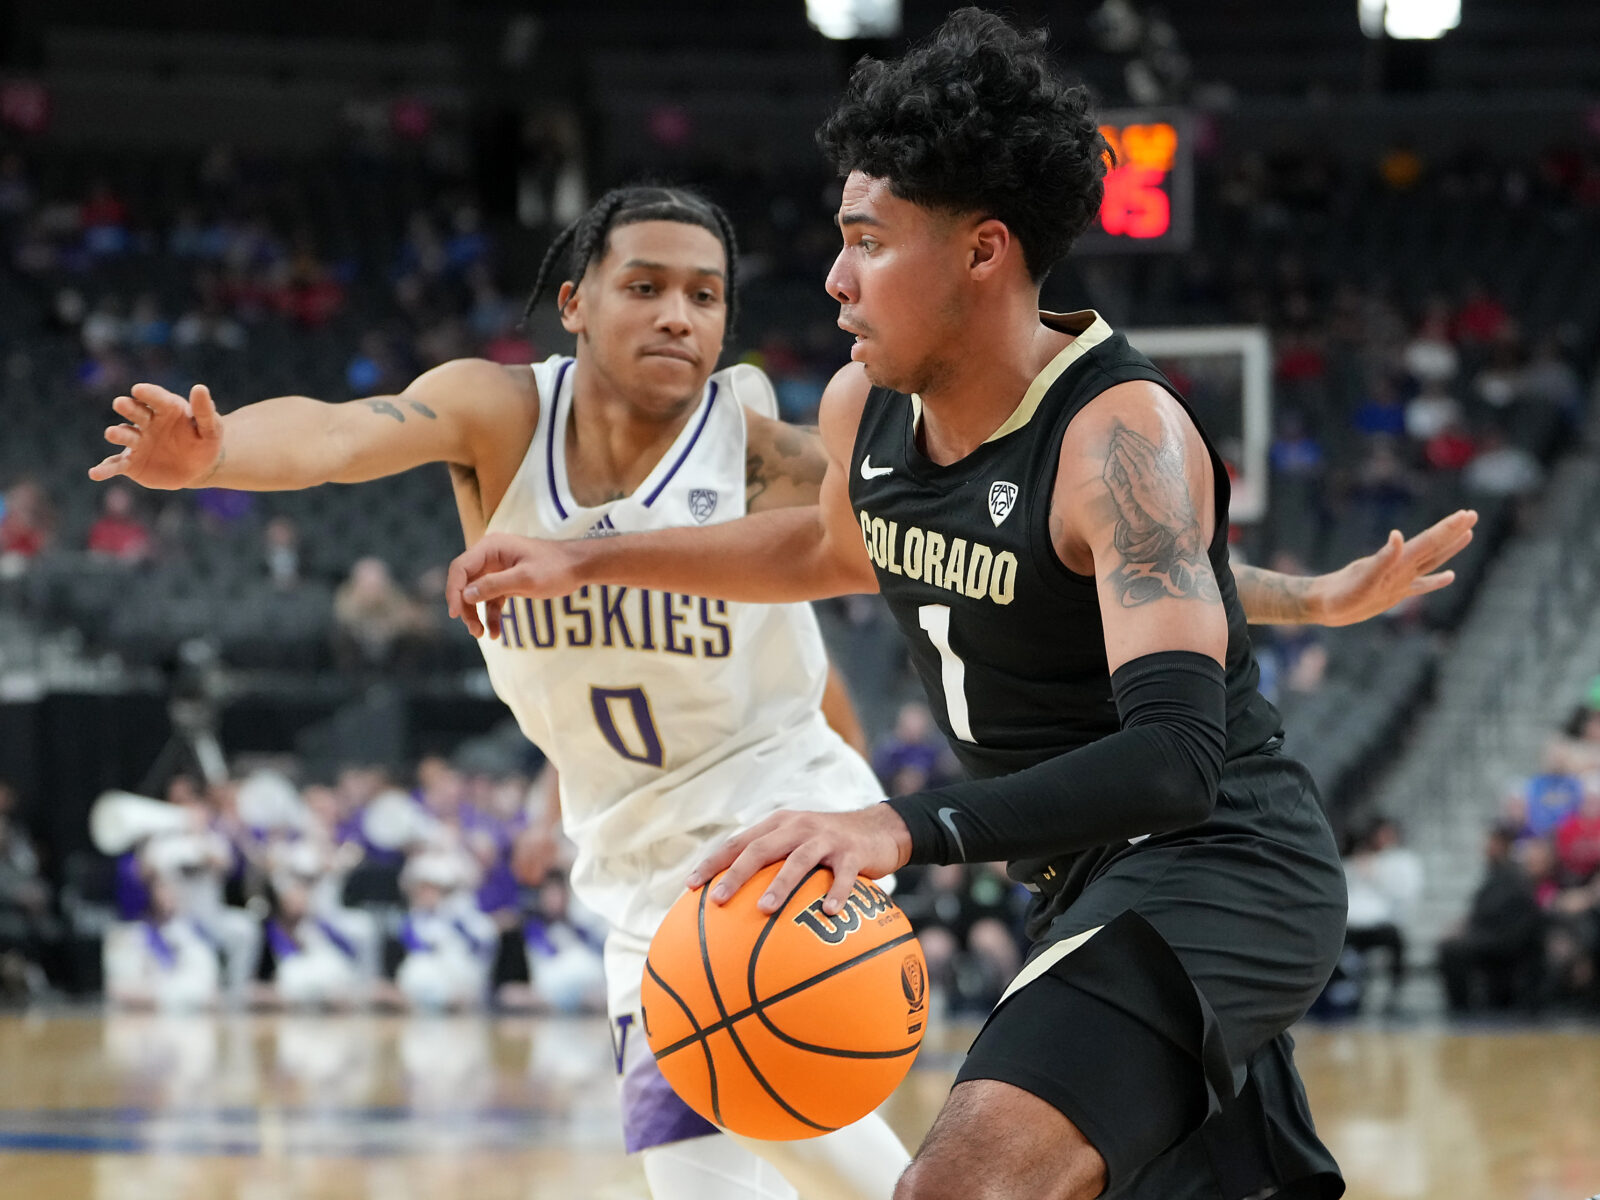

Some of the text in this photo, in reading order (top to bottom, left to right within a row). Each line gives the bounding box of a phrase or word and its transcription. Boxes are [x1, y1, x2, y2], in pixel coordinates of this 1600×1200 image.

[691, 490, 715, 509] PAC
[991, 484, 1016, 509] PAC
[993, 501, 1007, 517] 12
[694, 504, 710, 518] 12
[860, 510, 1018, 606] COLORADO
[918, 604, 978, 744] 1
[588, 683, 666, 769] 0
